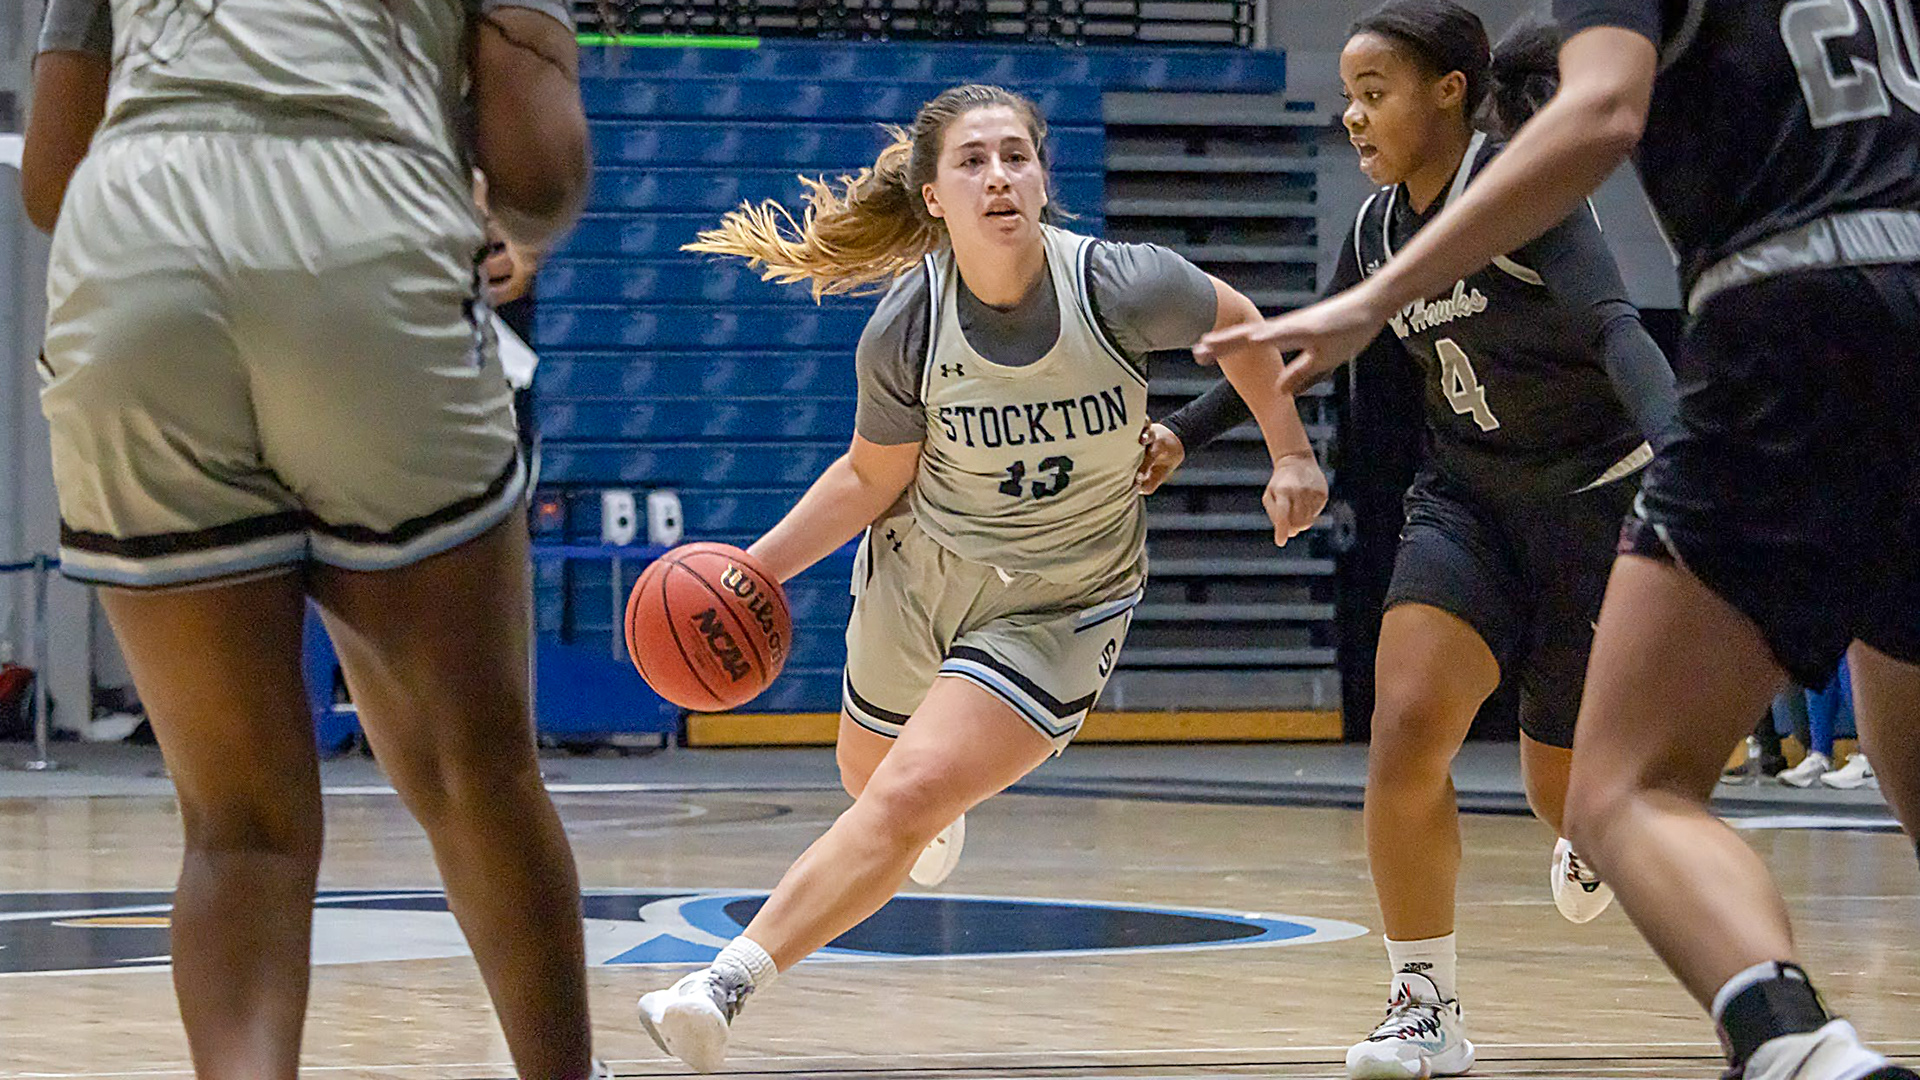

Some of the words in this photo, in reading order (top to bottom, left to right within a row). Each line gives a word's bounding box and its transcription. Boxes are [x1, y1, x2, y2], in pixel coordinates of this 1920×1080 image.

[938, 385, 1129, 448] STOCKTON
[1435, 338, 1500, 432] 4
[998, 455, 1074, 500] 13
[690, 607, 752, 683] NCAA
[720, 562, 784, 667] Wilson
